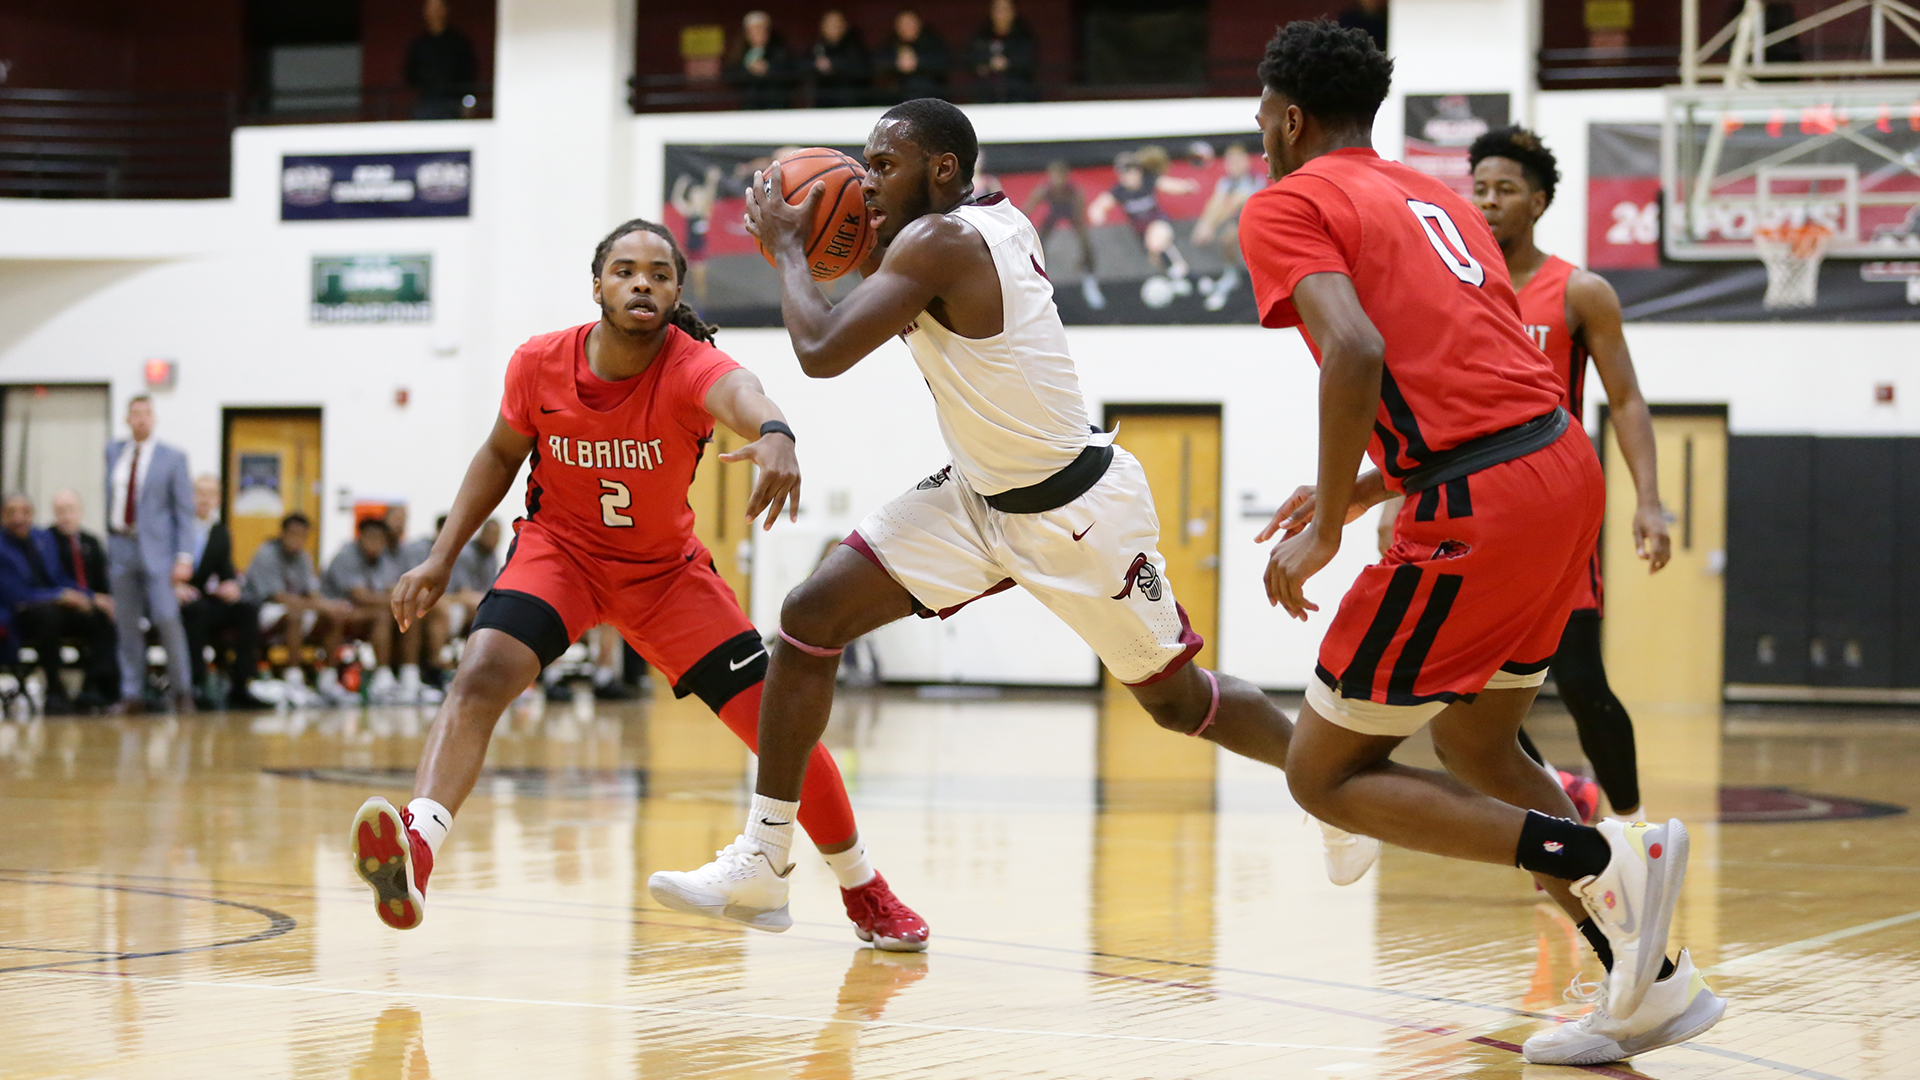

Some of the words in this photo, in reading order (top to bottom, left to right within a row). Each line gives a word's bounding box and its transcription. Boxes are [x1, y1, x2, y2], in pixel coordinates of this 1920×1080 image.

[824, 212, 860, 259] ROCK
[1405, 198, 1485, 288] 0
[1606, 202, 1661, 245] 26
[810, 260, 840, 279] HE
[547, 434, 664, 471] ALBRIGHT
[597, 477, 636, 528] 2
